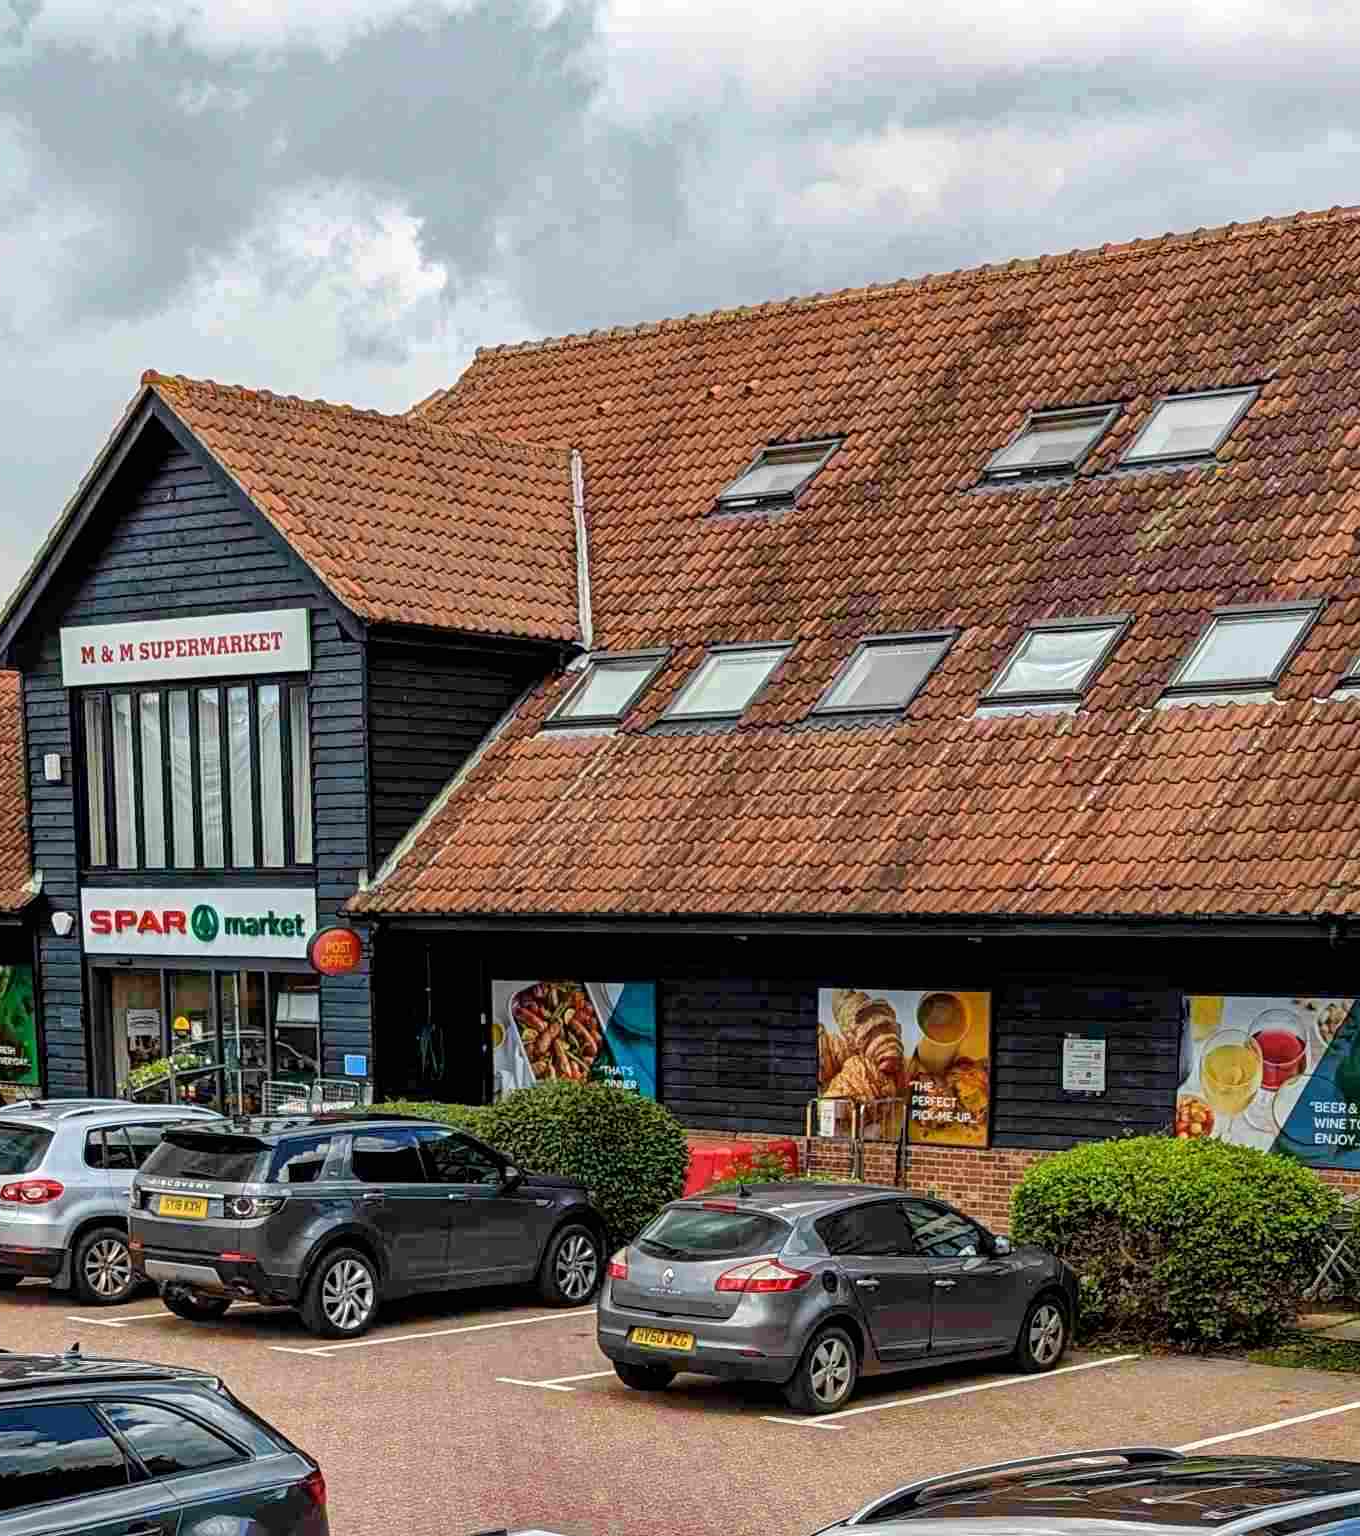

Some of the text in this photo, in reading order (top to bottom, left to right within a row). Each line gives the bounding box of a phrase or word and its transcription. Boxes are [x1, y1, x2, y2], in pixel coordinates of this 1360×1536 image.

[81, 631, 284, 664] M & M SUPERMARKET
[90, 910, 306, 937] SPAR market
[326, 942, 352, 953] POST
[912, 1096, 958, 1108] PERFECT
[1348, 1103, 1359, 1114] &
[1314, 1117, 1346, 1130] WINE
